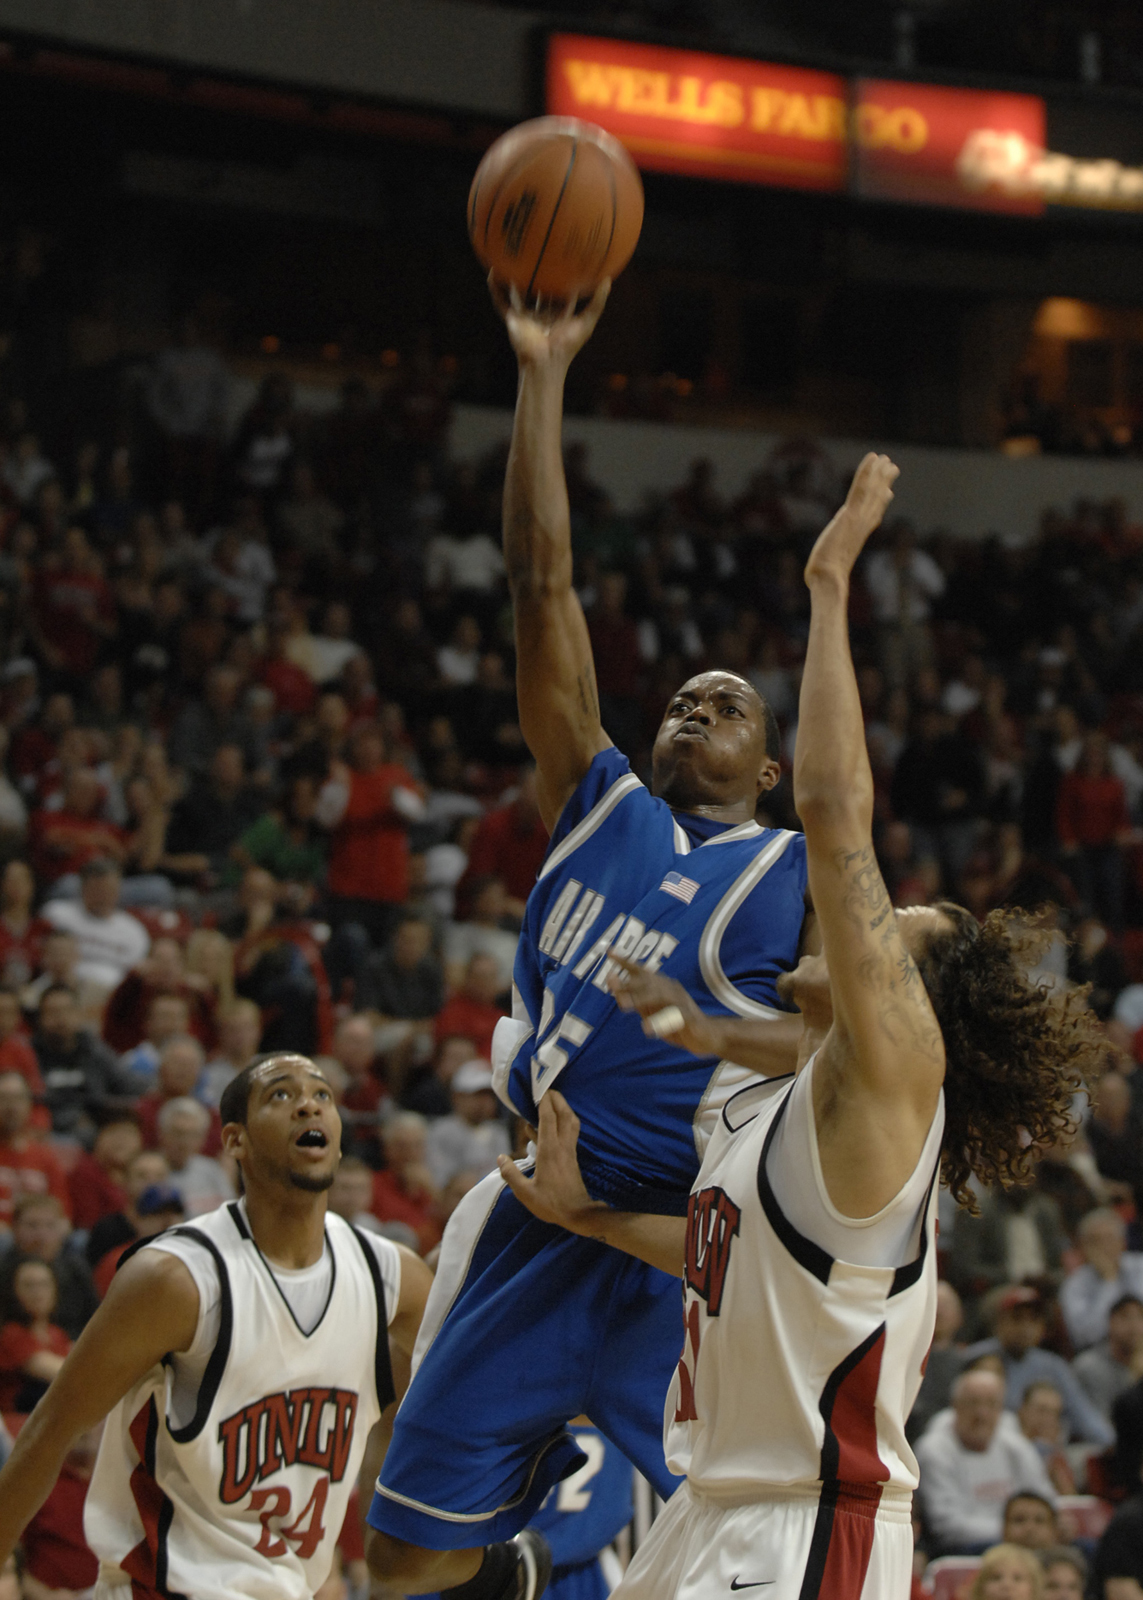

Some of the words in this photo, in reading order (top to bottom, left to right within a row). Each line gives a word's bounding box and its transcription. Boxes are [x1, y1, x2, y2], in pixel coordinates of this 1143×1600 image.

[564, 59, 745, 128] WELLS
[217, 1386, 359, 1504] UNLV
[244, 1475, 330, 1560] 24
